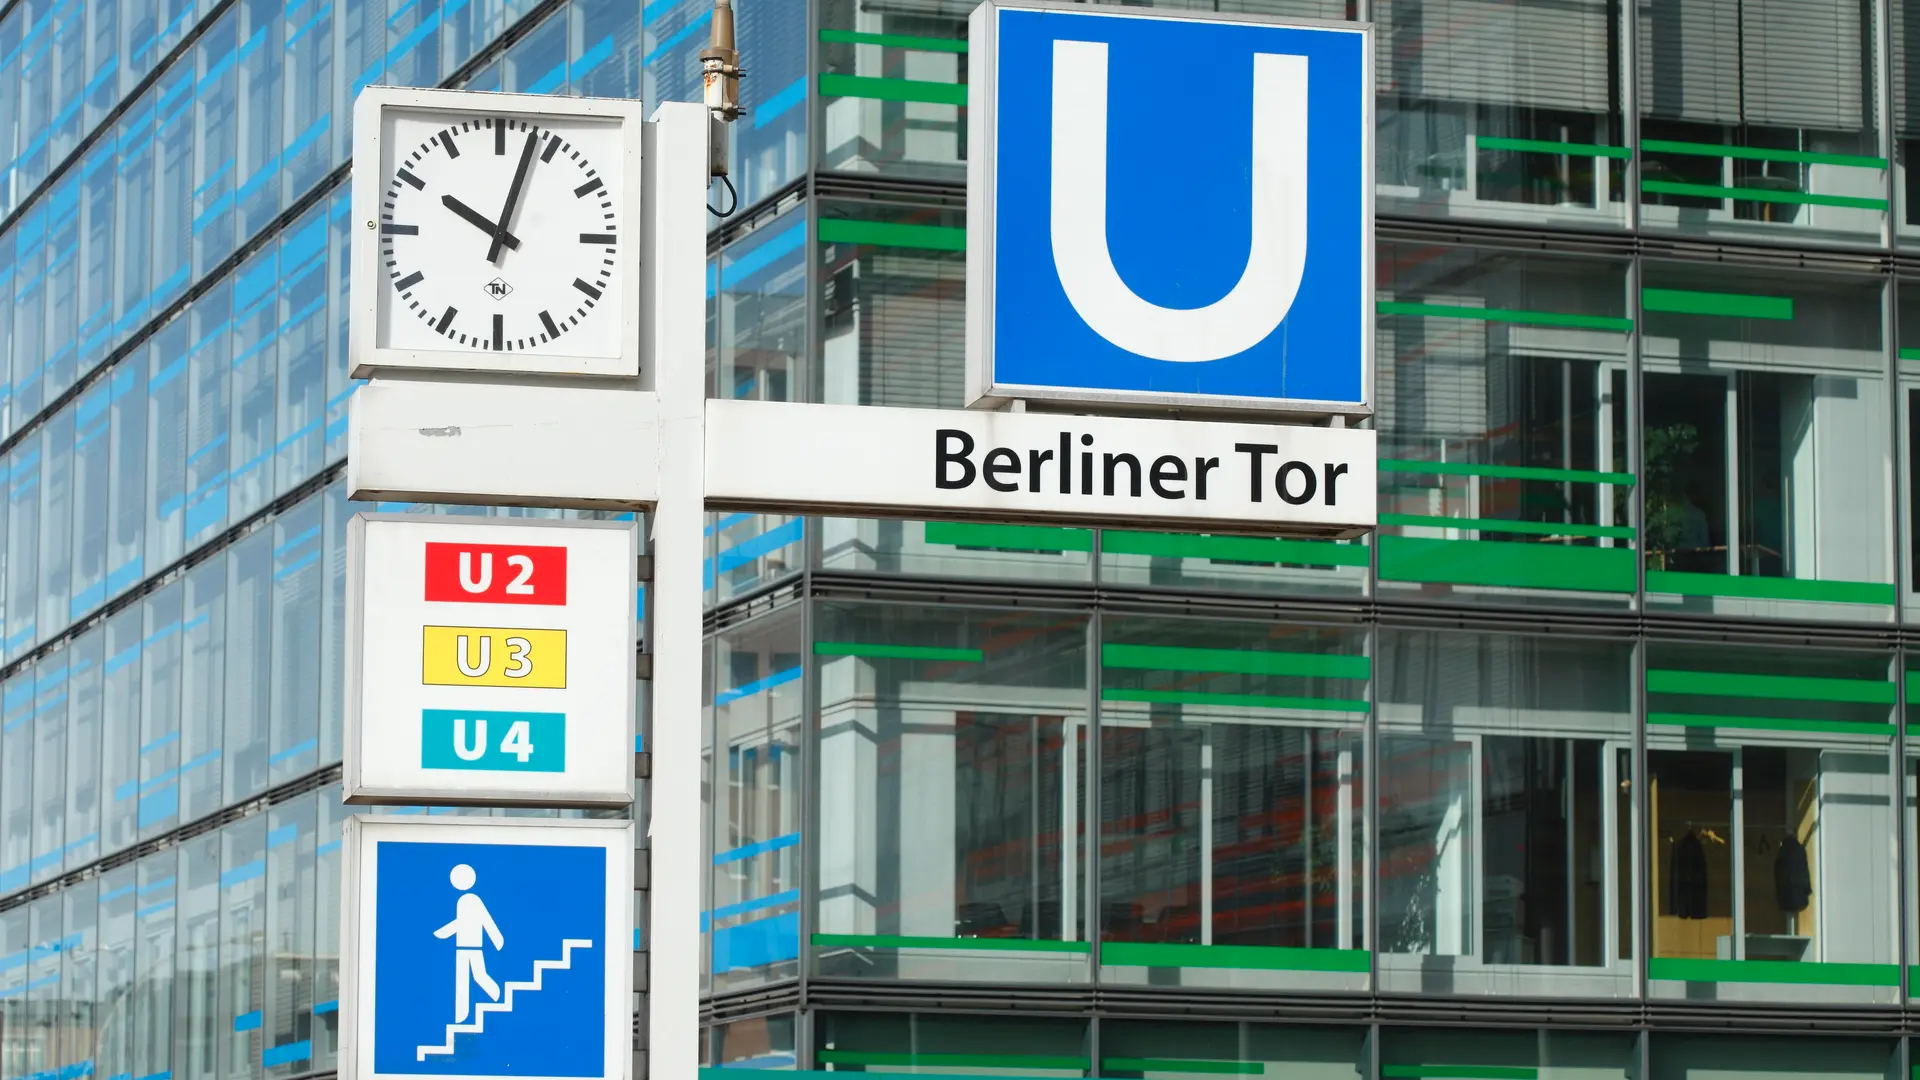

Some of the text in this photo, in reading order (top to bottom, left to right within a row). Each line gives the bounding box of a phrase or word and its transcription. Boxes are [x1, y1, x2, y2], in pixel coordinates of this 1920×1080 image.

[1051, 39, 1309, 363] U
[936, 430, 1347, 505] Berliner Tor
